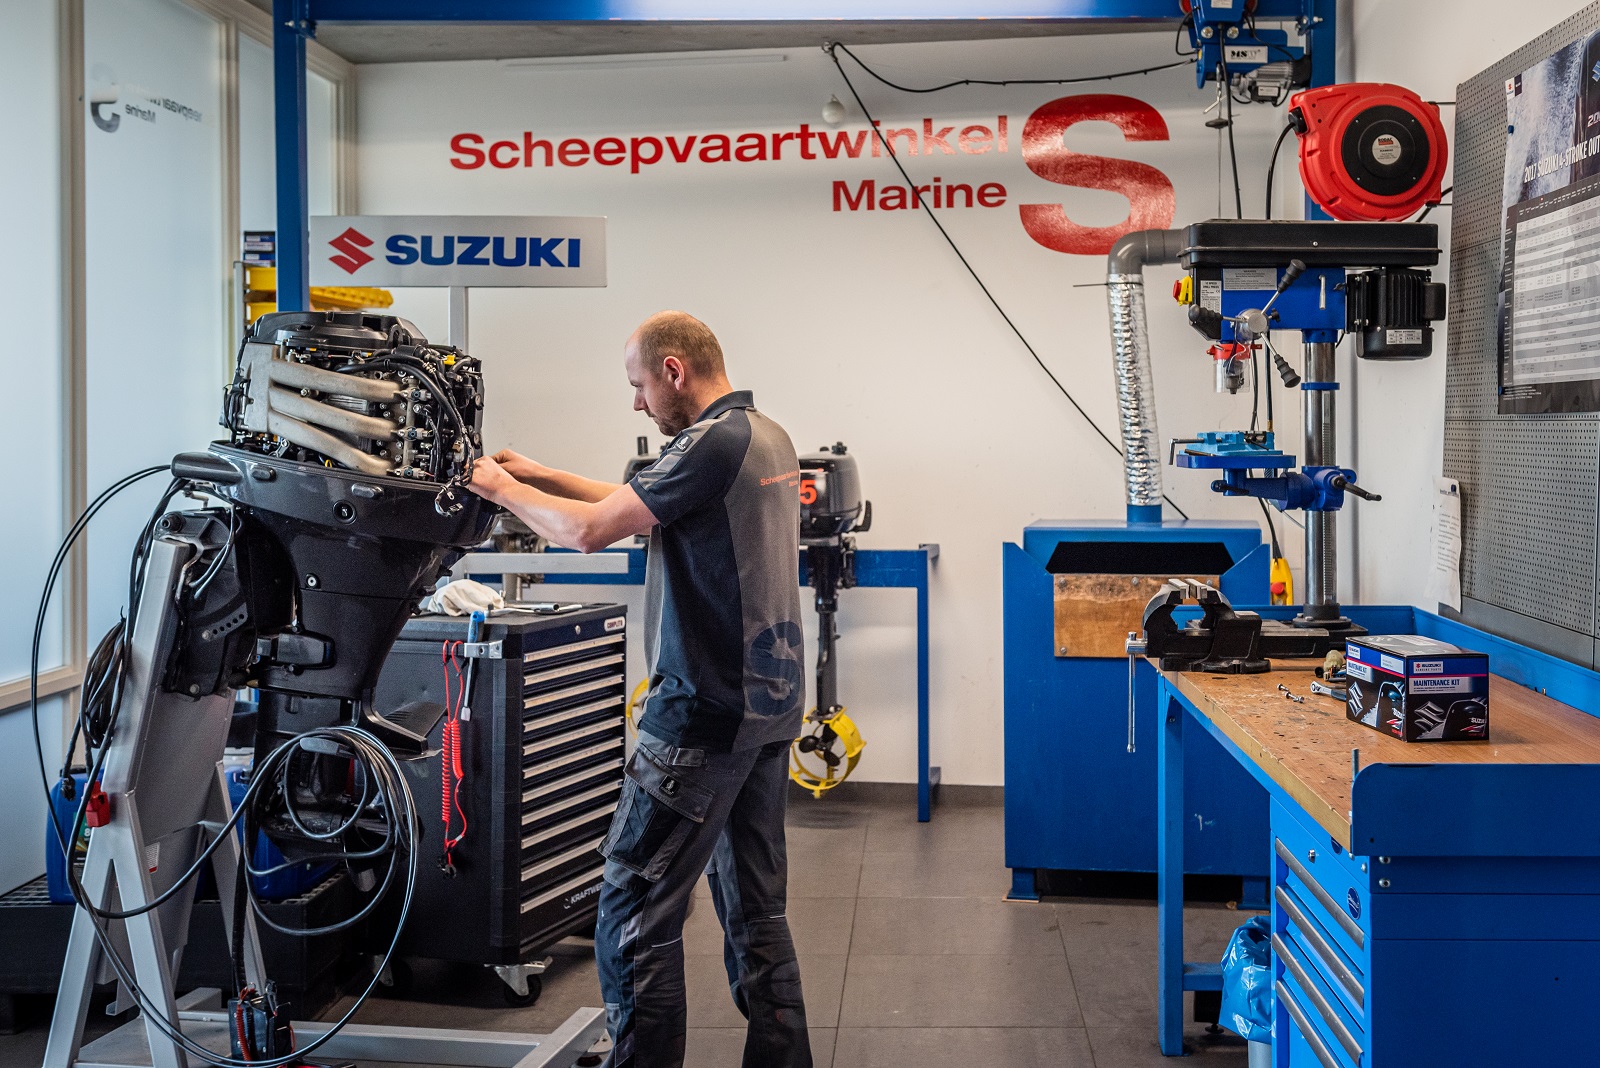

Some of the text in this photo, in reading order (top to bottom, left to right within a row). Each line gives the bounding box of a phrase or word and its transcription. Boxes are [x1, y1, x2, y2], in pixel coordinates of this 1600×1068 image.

[449, 114, 1009, 174] Scheepvaartwinkel
[1018, 93, 1176, 256] S
[1524, 165, 1537, 183] 2017
[1537, 154, 1559, 178] SUZUKI
[832, 176, 1008, 212] Marine
[385, 234, 581, 269] SUZUKI
[1413, 679, 1450, 687] MAINTENANCE
